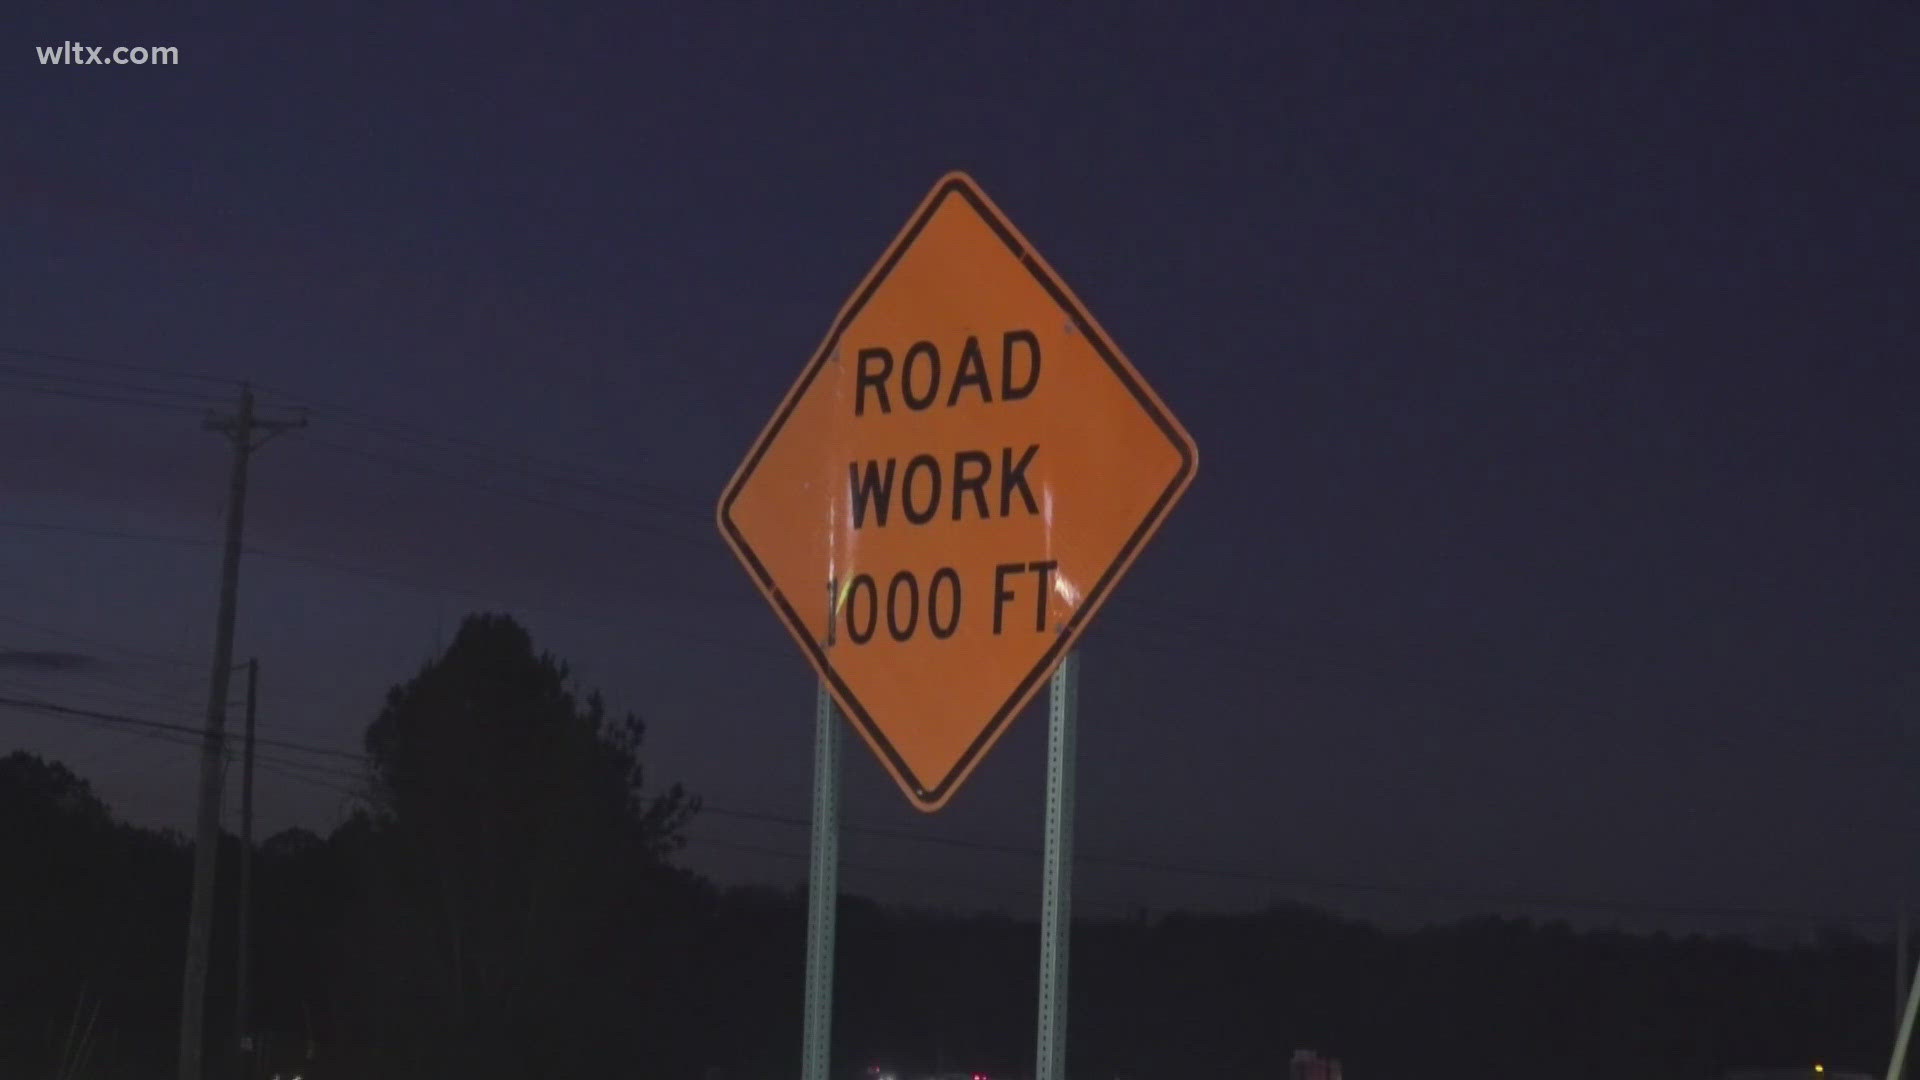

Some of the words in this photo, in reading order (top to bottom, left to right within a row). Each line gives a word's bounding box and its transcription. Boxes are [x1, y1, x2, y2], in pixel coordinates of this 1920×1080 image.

[854, 329, 1041, 417] ROAD
[849, 443, 1040, 530] WORK
[826, 566, 962, 647] 1000
[992, 560, 1058, 635] FT
